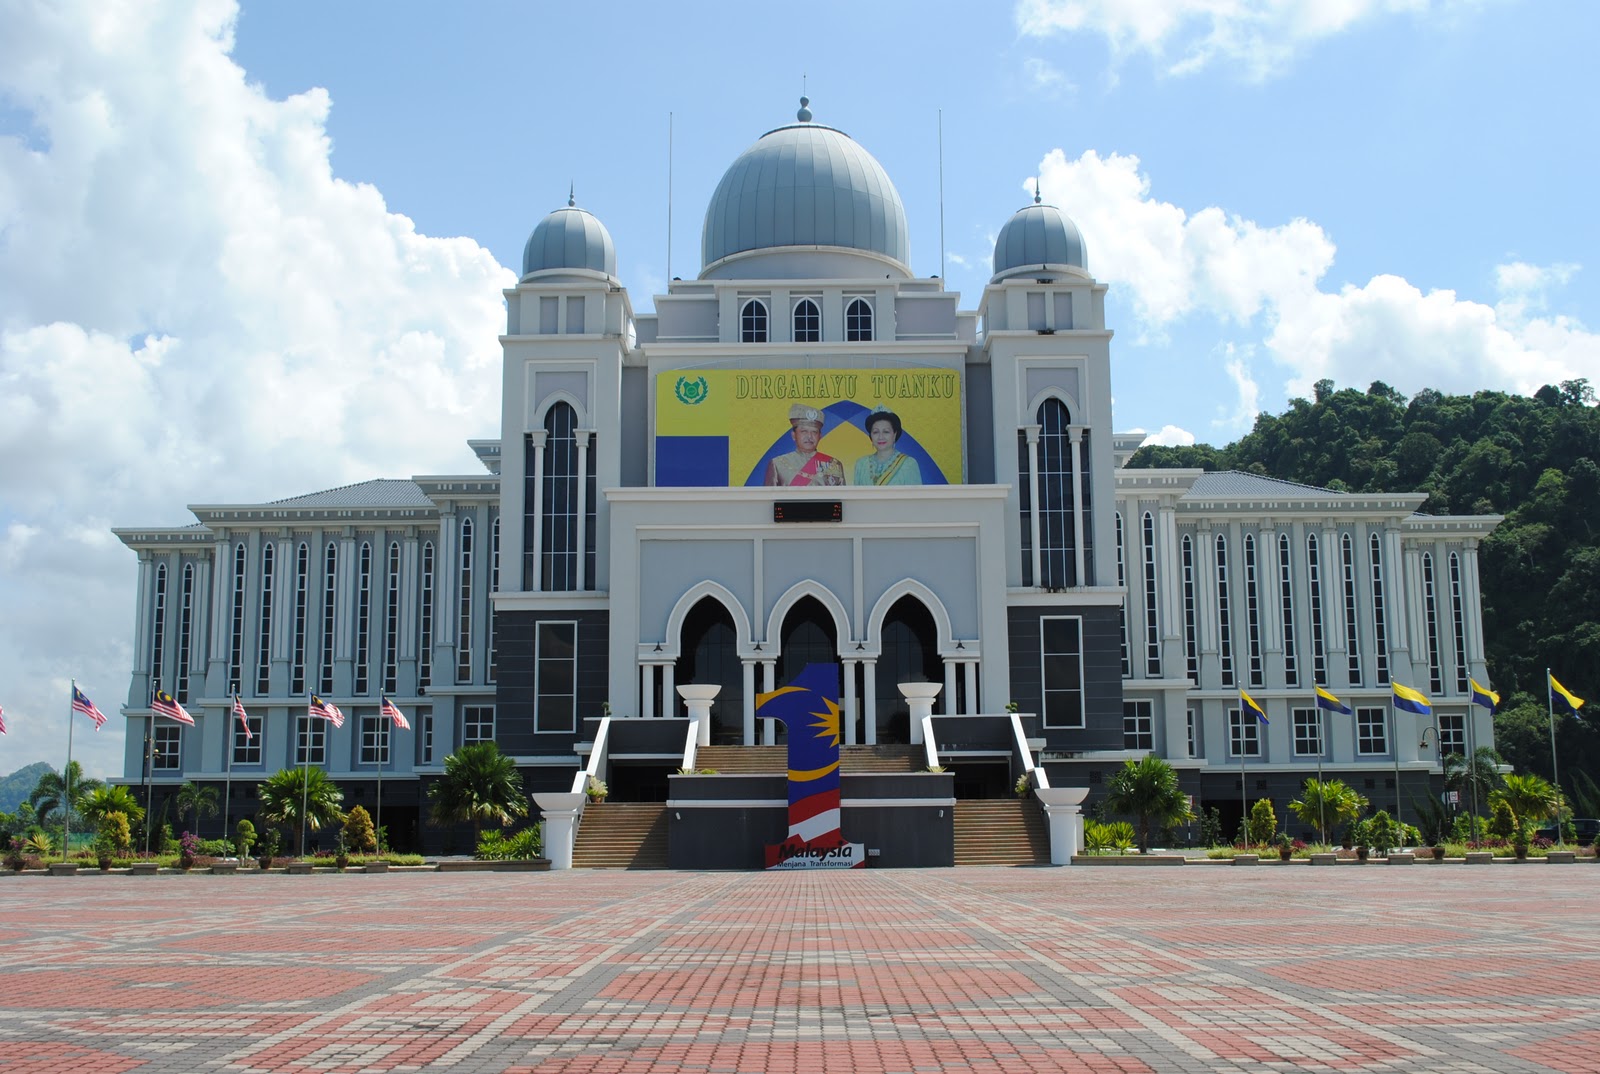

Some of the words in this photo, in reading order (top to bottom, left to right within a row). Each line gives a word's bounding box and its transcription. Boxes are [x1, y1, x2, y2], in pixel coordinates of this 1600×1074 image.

[736, 374, 857, 399] DIRGAHAYU
[871, 374, 955, 398] TUANKU
[778, 842, 853, 861] Malaysia
